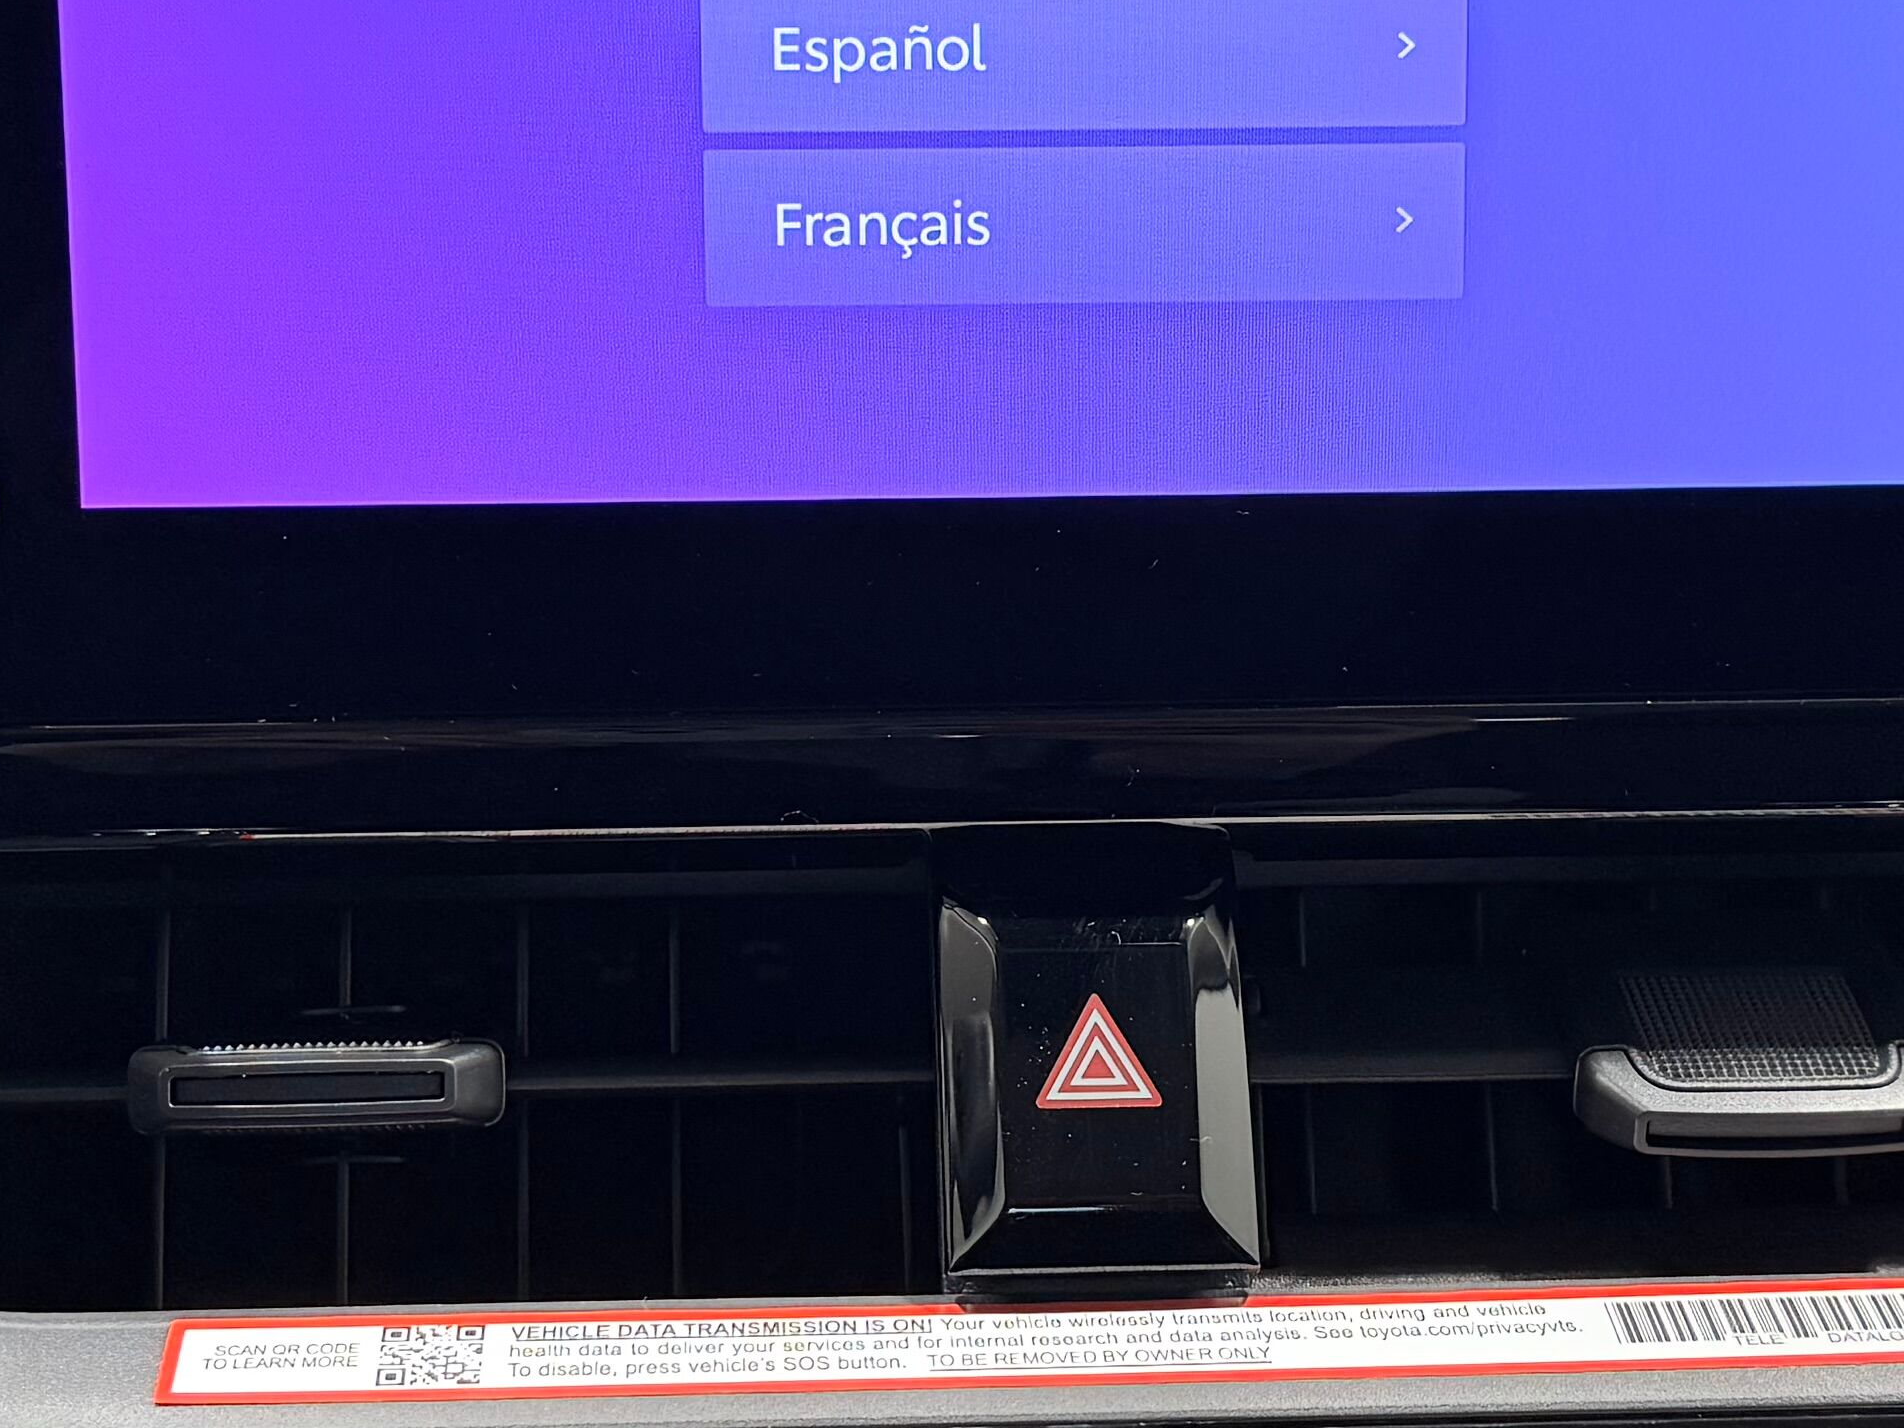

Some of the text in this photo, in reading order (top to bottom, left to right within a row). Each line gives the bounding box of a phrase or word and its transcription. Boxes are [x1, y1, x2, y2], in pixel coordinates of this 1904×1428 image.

[771, 24, 986, 84] Español
[775, 199, 991, 259] Français
[510, 1324, 611, 1340] VEHICLE
[617, 1322, 677, 1339] DATA
[683, 1319, 858, 1338] TRANSMISSION
[865, 1319, 884, 1334] IS
[940, 1317, 986, 1331] Your
[992, 1315, 1061, 1330] vehicle
[1068, 1312, 1165, 1329] wirelessly
[1171, 1310, 1263, 1326] transmits
[1269, 1306, 1354, 1323] location,
[1360, 1307, 1426, 1322] driving
[1432, 1305, 1470, 1319] and
[1476, 1302, 1547, 1318] vehicle
[214, 1342, 361, 1356] SCAN QR CODE
[508, 1344, 571, 1358] health
[578, 1343, 623, 1357] data
[631, 1343, 649, 1356] to
[657, 1341, 725, 1356] deliver
[732, 1341, 775, 1358] your
[783, 1338, 866, 1352] services
[873, 1336, 909, 1350] and
[917, 1335, 943, 1349] for
[950, 1334, 1025, 1349] internal
[1031, 1332, 1118, 1347] research
[1126, 1331, 1162, 1344] and
[1170, 1329, 1213, 1343] data
[1220, 1326, 1308, 1343] analysis.
[1313, 1325, 1354, 1339] See
[1731, 1333, 1785, 1346] TELE
[201, 1355, 360, 1370] TO LEARN MORE
[508, 1346, 1271, 1378] To disable, press vehicle's SOS button. TO BE REMOVED BY OWNER ONLY
